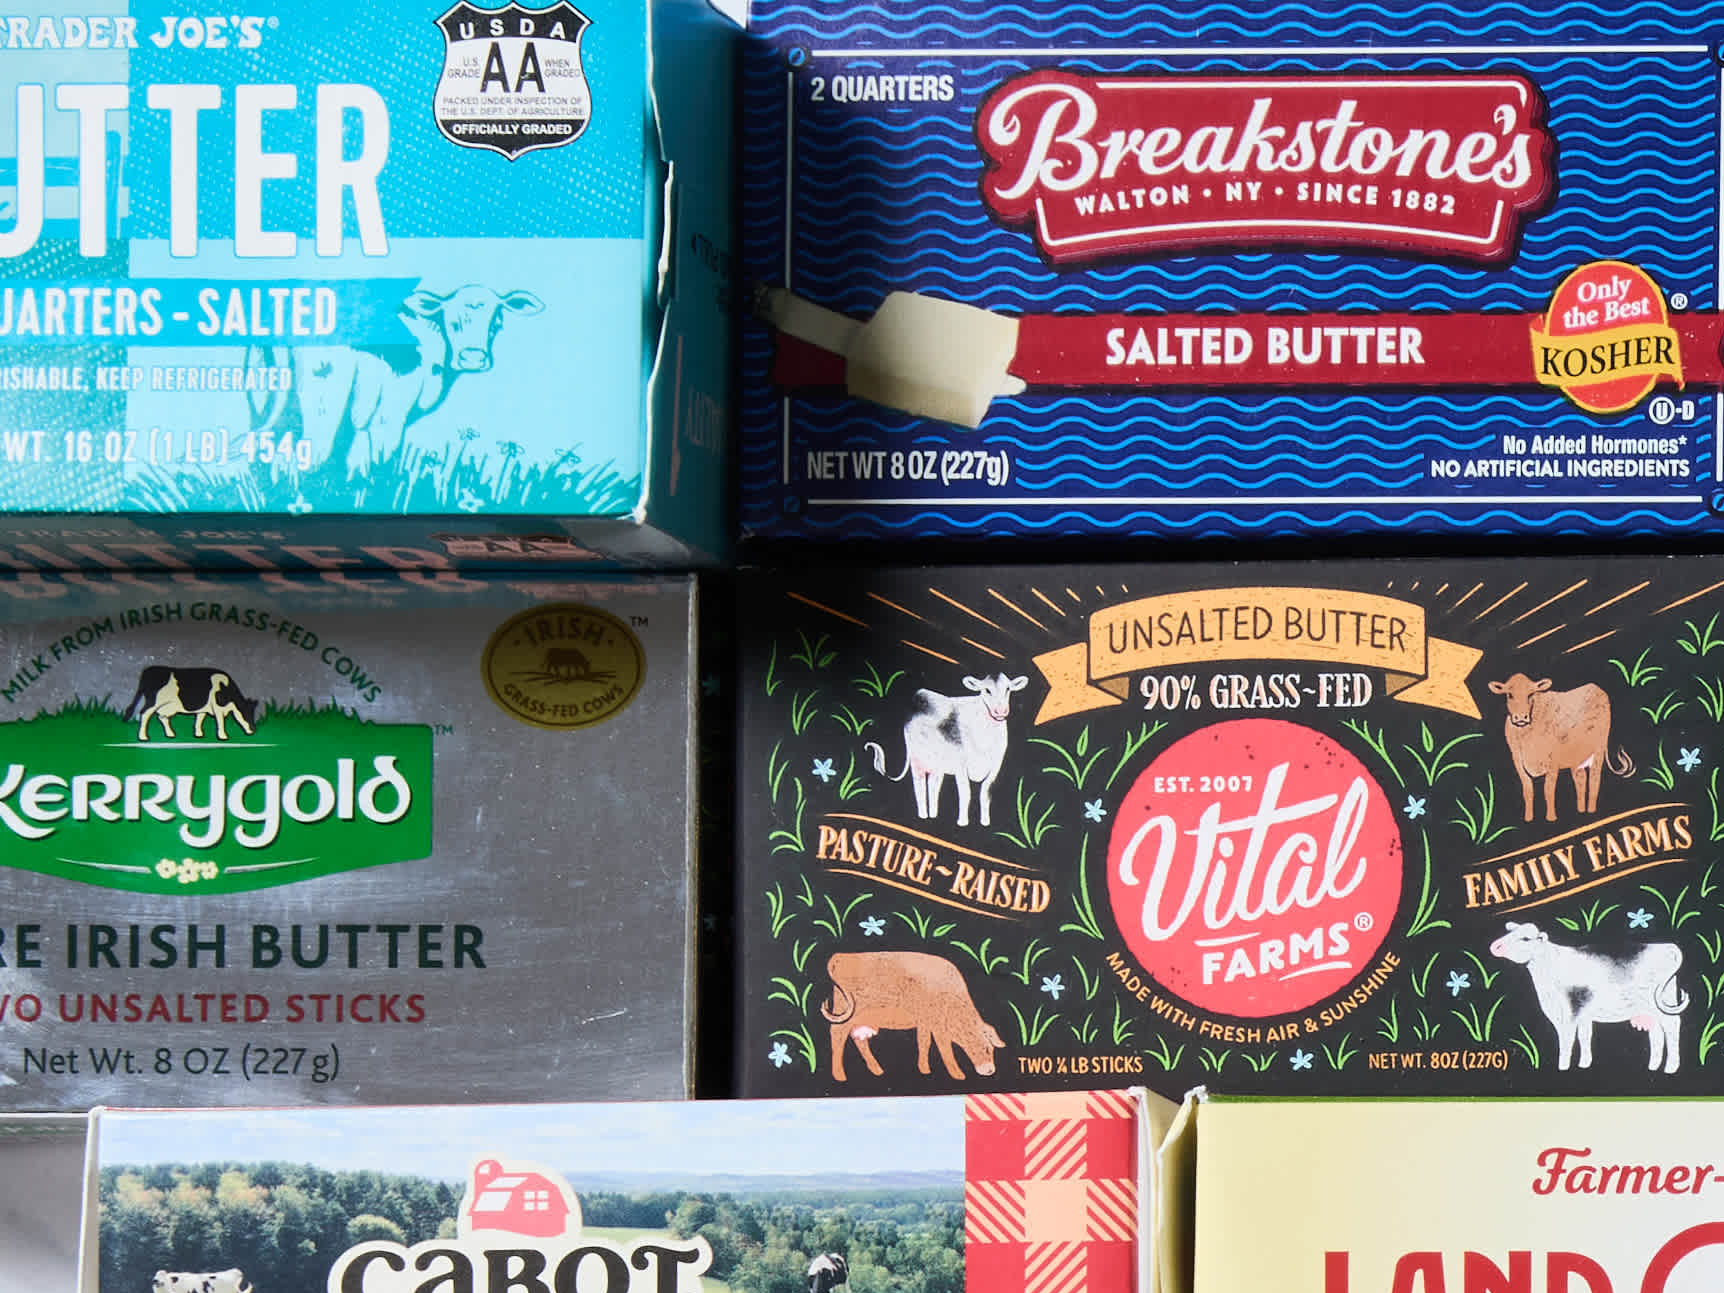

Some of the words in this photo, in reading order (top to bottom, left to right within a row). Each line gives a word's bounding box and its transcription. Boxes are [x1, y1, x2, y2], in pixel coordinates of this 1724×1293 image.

[0, 16, 138, 49] RADER
[460, 19, 565, 40] USDA
[480, 40, 545, 93] AA
[811, 77, 825, 101] 2
[832, 75, 954, 102] QUARTERS
[453, 124, 519, 135] OFFICIALLY
[521, 124, 572, 135] GRADED
[988, 82, 1531, 201] Breakstone's
[1075, 184, 1189, 216] WALTON
[1225, 182, 1261, 202] NY
[1297, 182, 1378, 206] SINCE
[1391, 190, 1456, 215] 1882
[1576, 275, 1632, 303] Only
[199, 289, 336, 336] SALTED
[1562, 306, 1600, 329] the
[1604, 297, 1651, 322] Best
[1105, 327, 1252, 366] SALTED
[1268, 327, 1425, 366] BUTTER
[1541, 335, 1675, 377] KOSHER
[1503, 436, 1526, 454] No
[1531, 435, 1586, 454] Added
[1431, 460, 1461, 478] NO
[1464, 459, 1562, 478] ARTIFICIAL
[1567, 459, 1689, 478] INGREDIENTS
[523, 620, 607, 644] IRISH
[1108, 606, 1272, 654] UNSALTED
[1286, 608, 1406, 651] BUTTER
[1464, 849, 1577, 909] FAMILY
[1585, 815, 1693, 869] FARMS
[66, 925, 225, 969] IRISH
[251, 925, 487, 969] BUTTER
[59, 994, 270, 1023] UNSALTED
[286, 994, 427, 1023] STICKS
[1019, 1056, 1053, 1073] TWO
[1071, 1056, 1088, 1073] LB
[1092, 1056, 1143, 1073] STICKS
